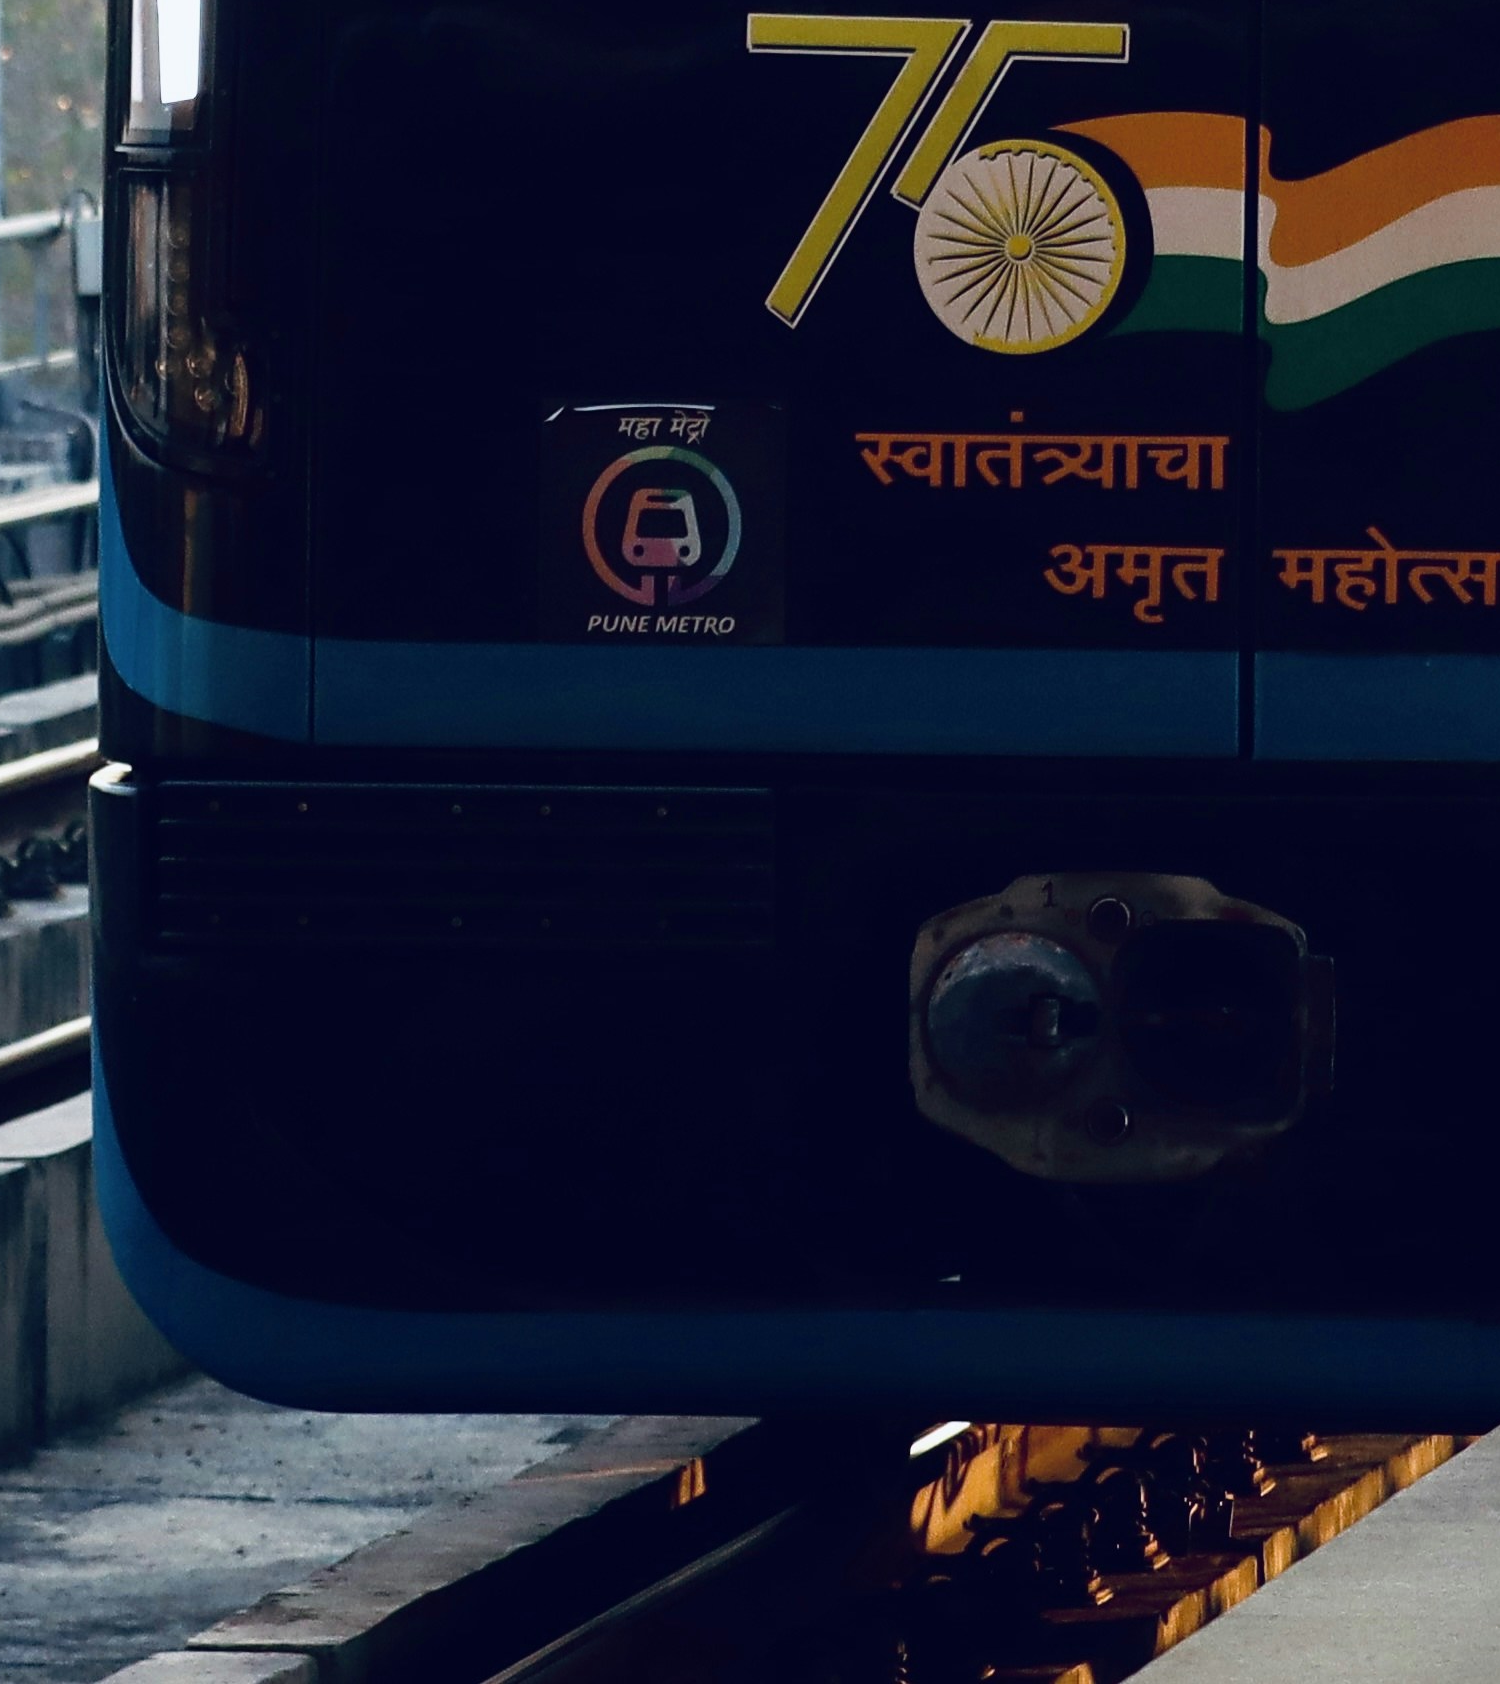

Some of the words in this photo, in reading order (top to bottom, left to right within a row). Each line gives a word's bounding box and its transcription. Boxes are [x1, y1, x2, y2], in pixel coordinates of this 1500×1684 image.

[618, 417, 661, 440] महा
[855, 411, 1230, 490] स्वातंत्र्याचा
[1043, 543, 1225, 623] अमृत
[587, 615, 650, 633] PUNE
[655, 616, 736, 636] METRO
